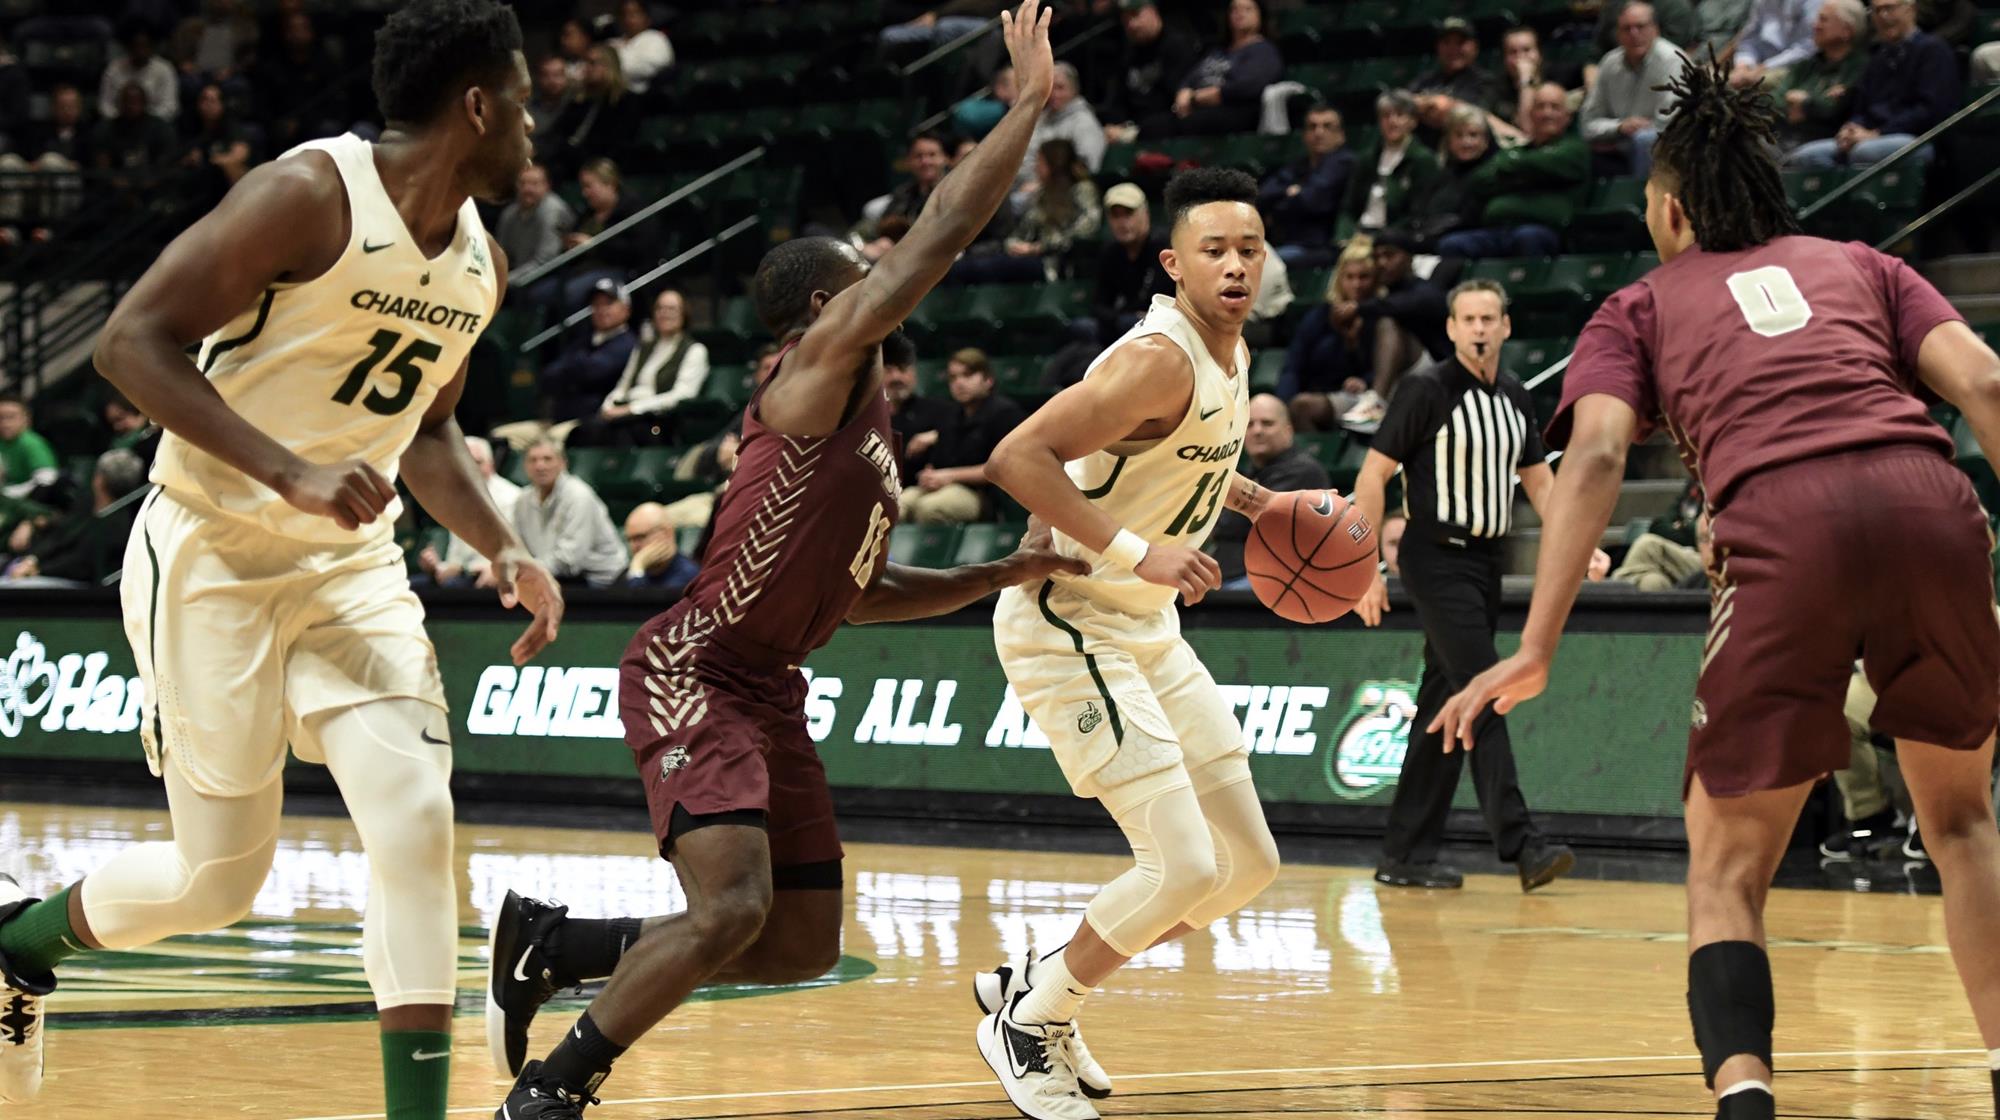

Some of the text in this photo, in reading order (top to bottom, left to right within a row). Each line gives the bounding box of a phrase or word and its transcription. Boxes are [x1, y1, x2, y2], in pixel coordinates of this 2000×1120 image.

[350, 289, 481, 334] CHARLOTTE
[1726, 265, 1813, 337] 0
[331, 328, 443, 416] 15
[1177, 437, 1242, 463] CHARLO
[1163, 468, 1229, 537] 13
[854, 678, 962, 745] ALL
